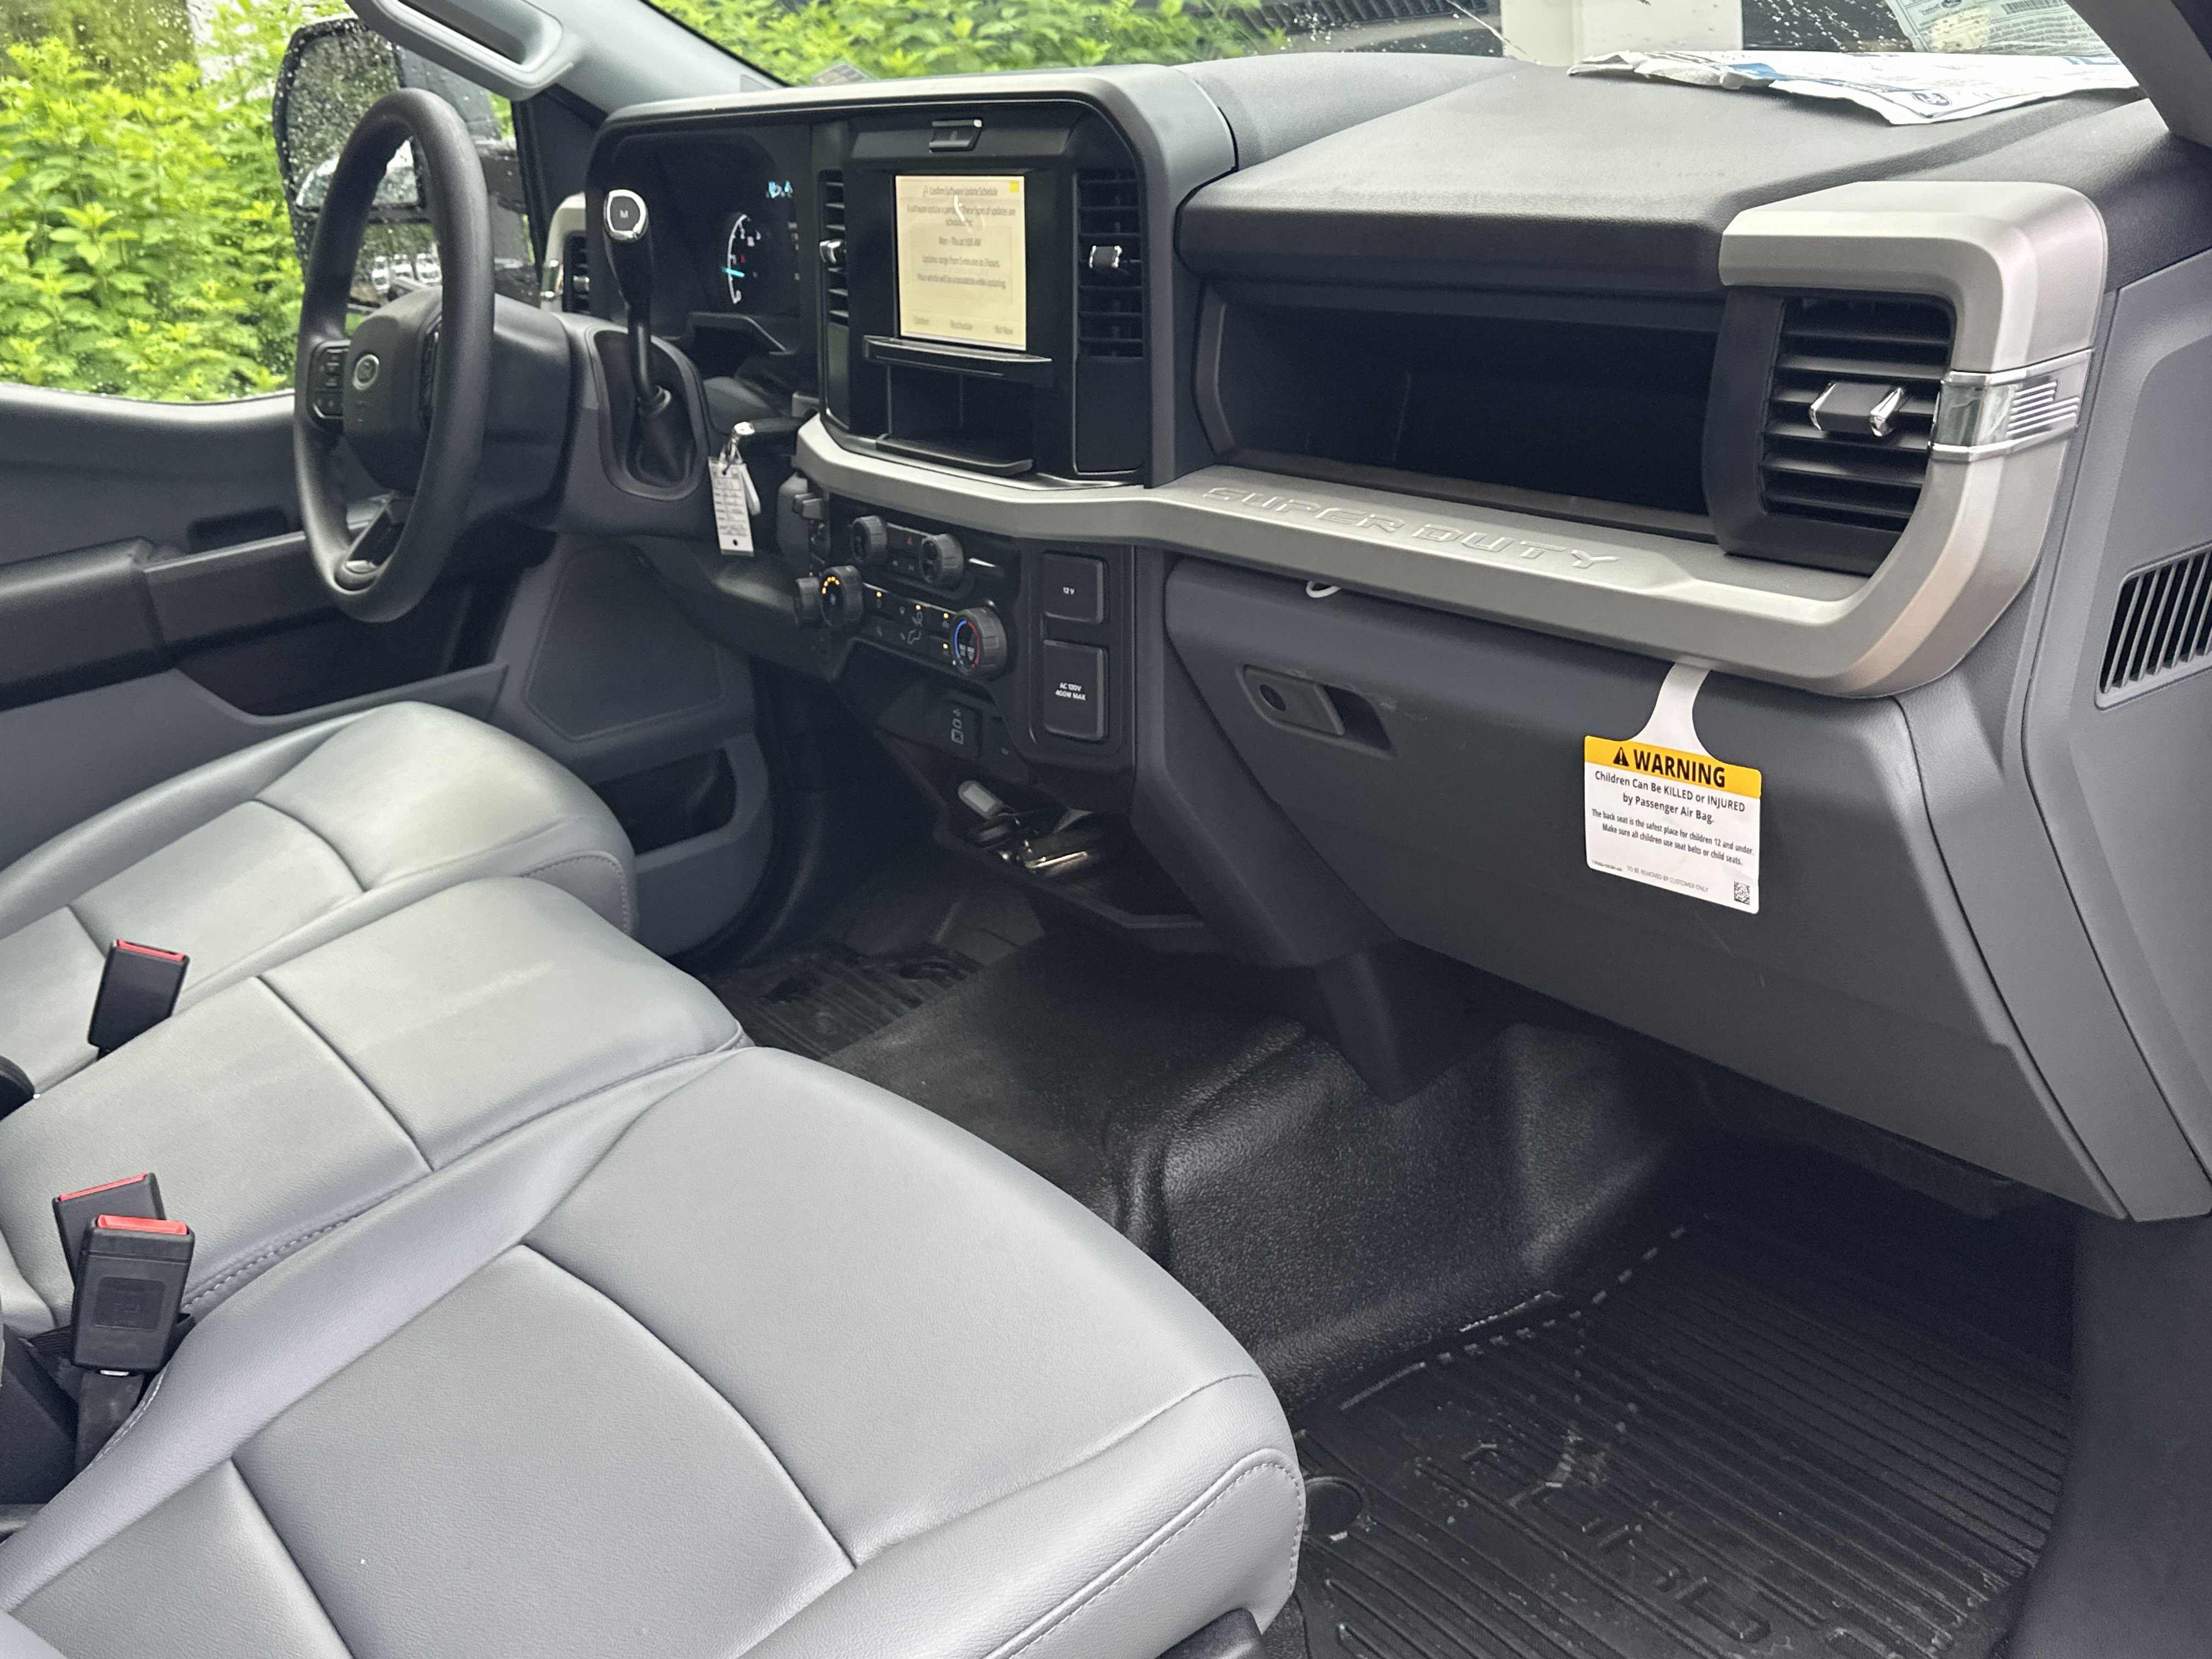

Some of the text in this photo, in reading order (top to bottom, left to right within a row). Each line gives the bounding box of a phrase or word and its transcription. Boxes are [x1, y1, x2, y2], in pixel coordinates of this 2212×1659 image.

[1203, 487, 1621, 569] SUPER DUTY
[1072, 692, 1086, 701] MAX
[1633, 749, 1726, 788] WARNING
[1595, 770, 1745, 812] Children Can Be KILLED or INJURED
[1623, 793, 1714, 825] by Passenger Air Bag.
[1592, 809, 1602, 818] The
[1602, 811, 1615, 821] back
[1617, 814, 1628, 824] seat
[1629, 817, 1634, 825] is
[1635, 819, 1644, 827] the
[1646, 820, 1662, 832] safest
[1664, 826, 1678, 837] place
[1690, 831, 1712, 844] children
[1714, 838, 1721, 847] 12
[1723, 839, 1734, 850] and
[1602, 823, 1617, 834] Make
[1618, 828, 1630, 837] sure
[1640, 832, 1662, 844] children
[1663, 839, 1673, 848] use
[1674, 842, 1686, 851] seat
[1688, 844, 1701, 855] belts
[1711, 850, 1724, 860] child
[1726, 855, 1743, 866] seats.
[1640, 868, 1663, 880] REMOVED
[1669, 877, 1695, 889] CUSTOMER
[1695, 884, 1709, 893] ONLY
